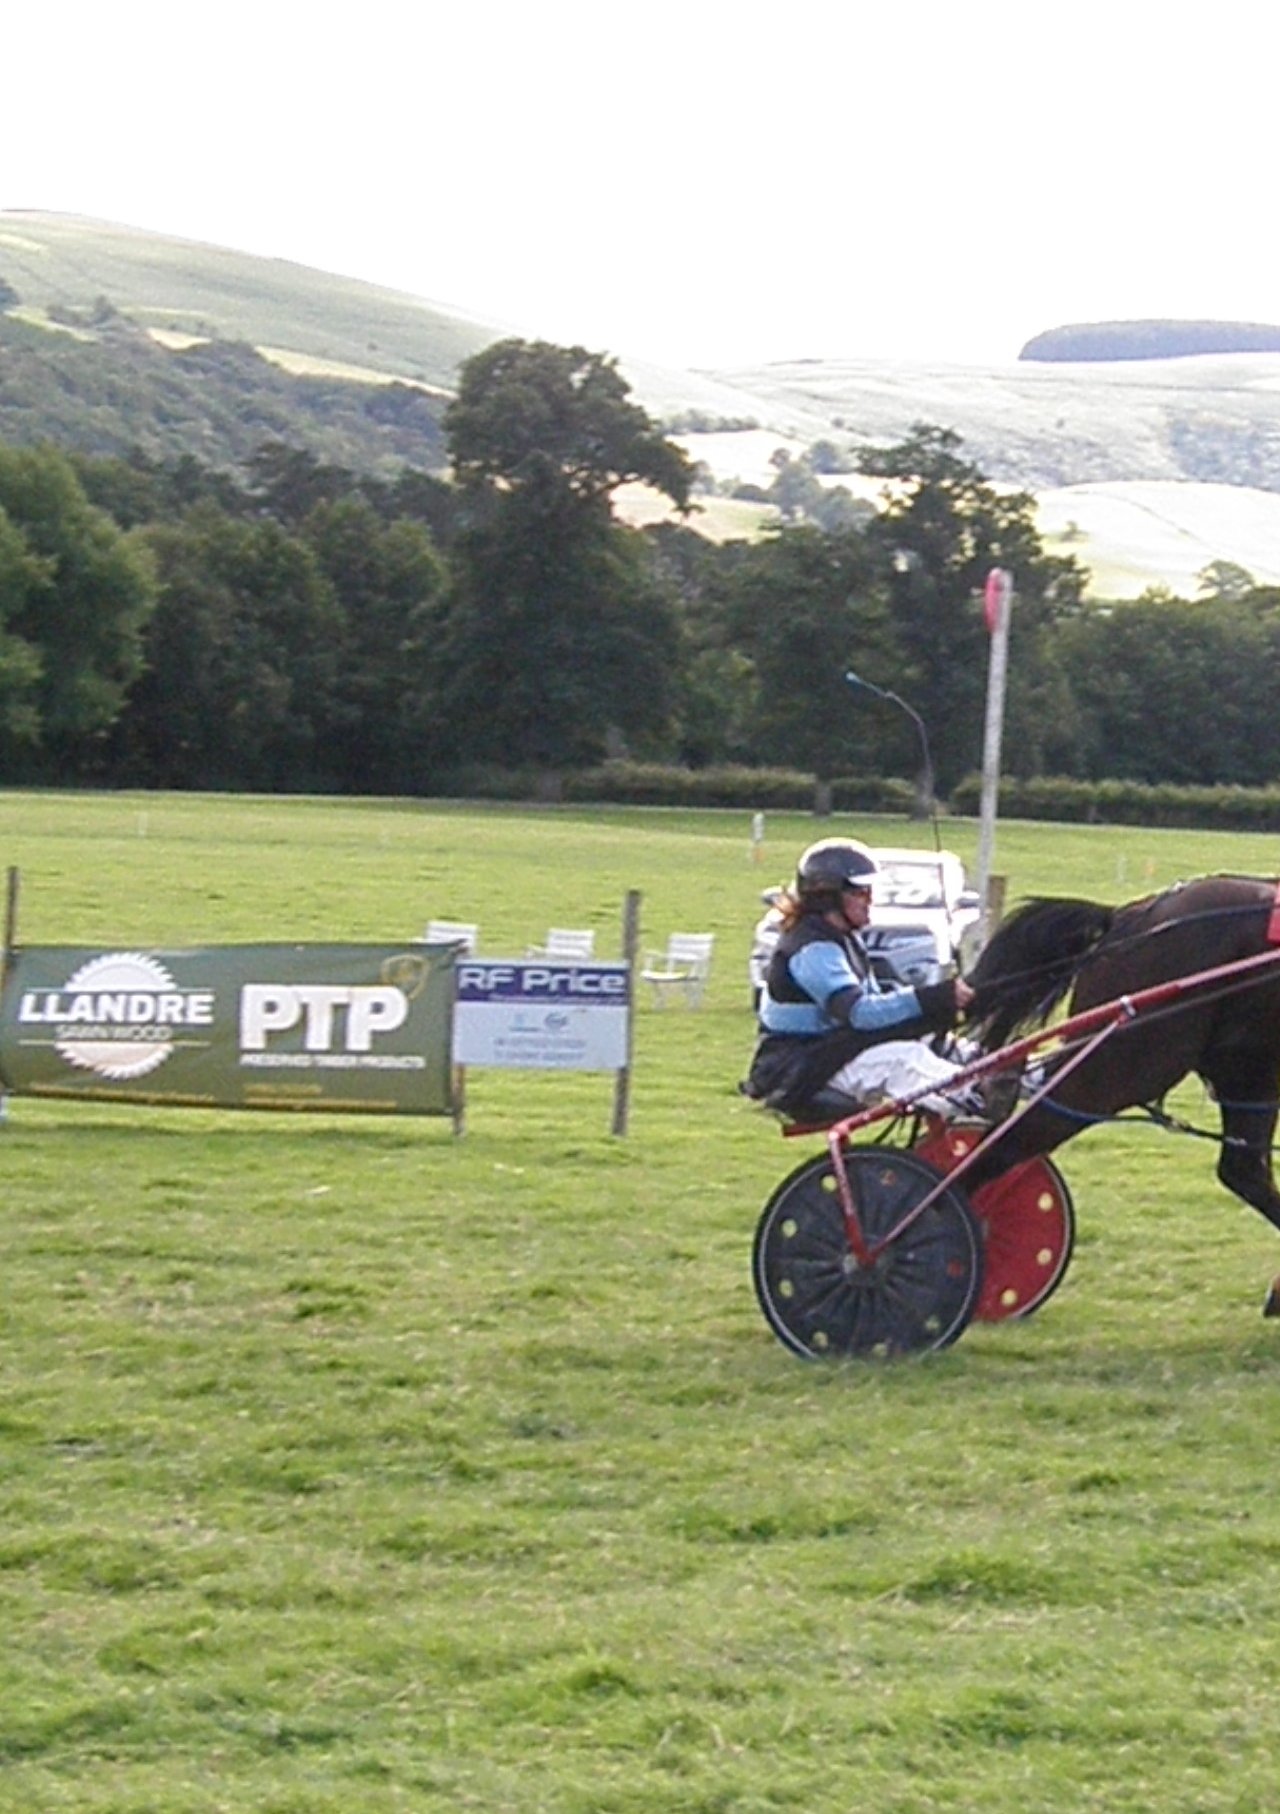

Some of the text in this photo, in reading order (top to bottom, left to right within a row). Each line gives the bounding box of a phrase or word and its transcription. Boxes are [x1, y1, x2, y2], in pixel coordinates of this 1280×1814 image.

[458, 967, 627, 994] RF Price
[18, 993, 214, 1024] LLANDRE
[239, 983, 408, 1052] PTP
